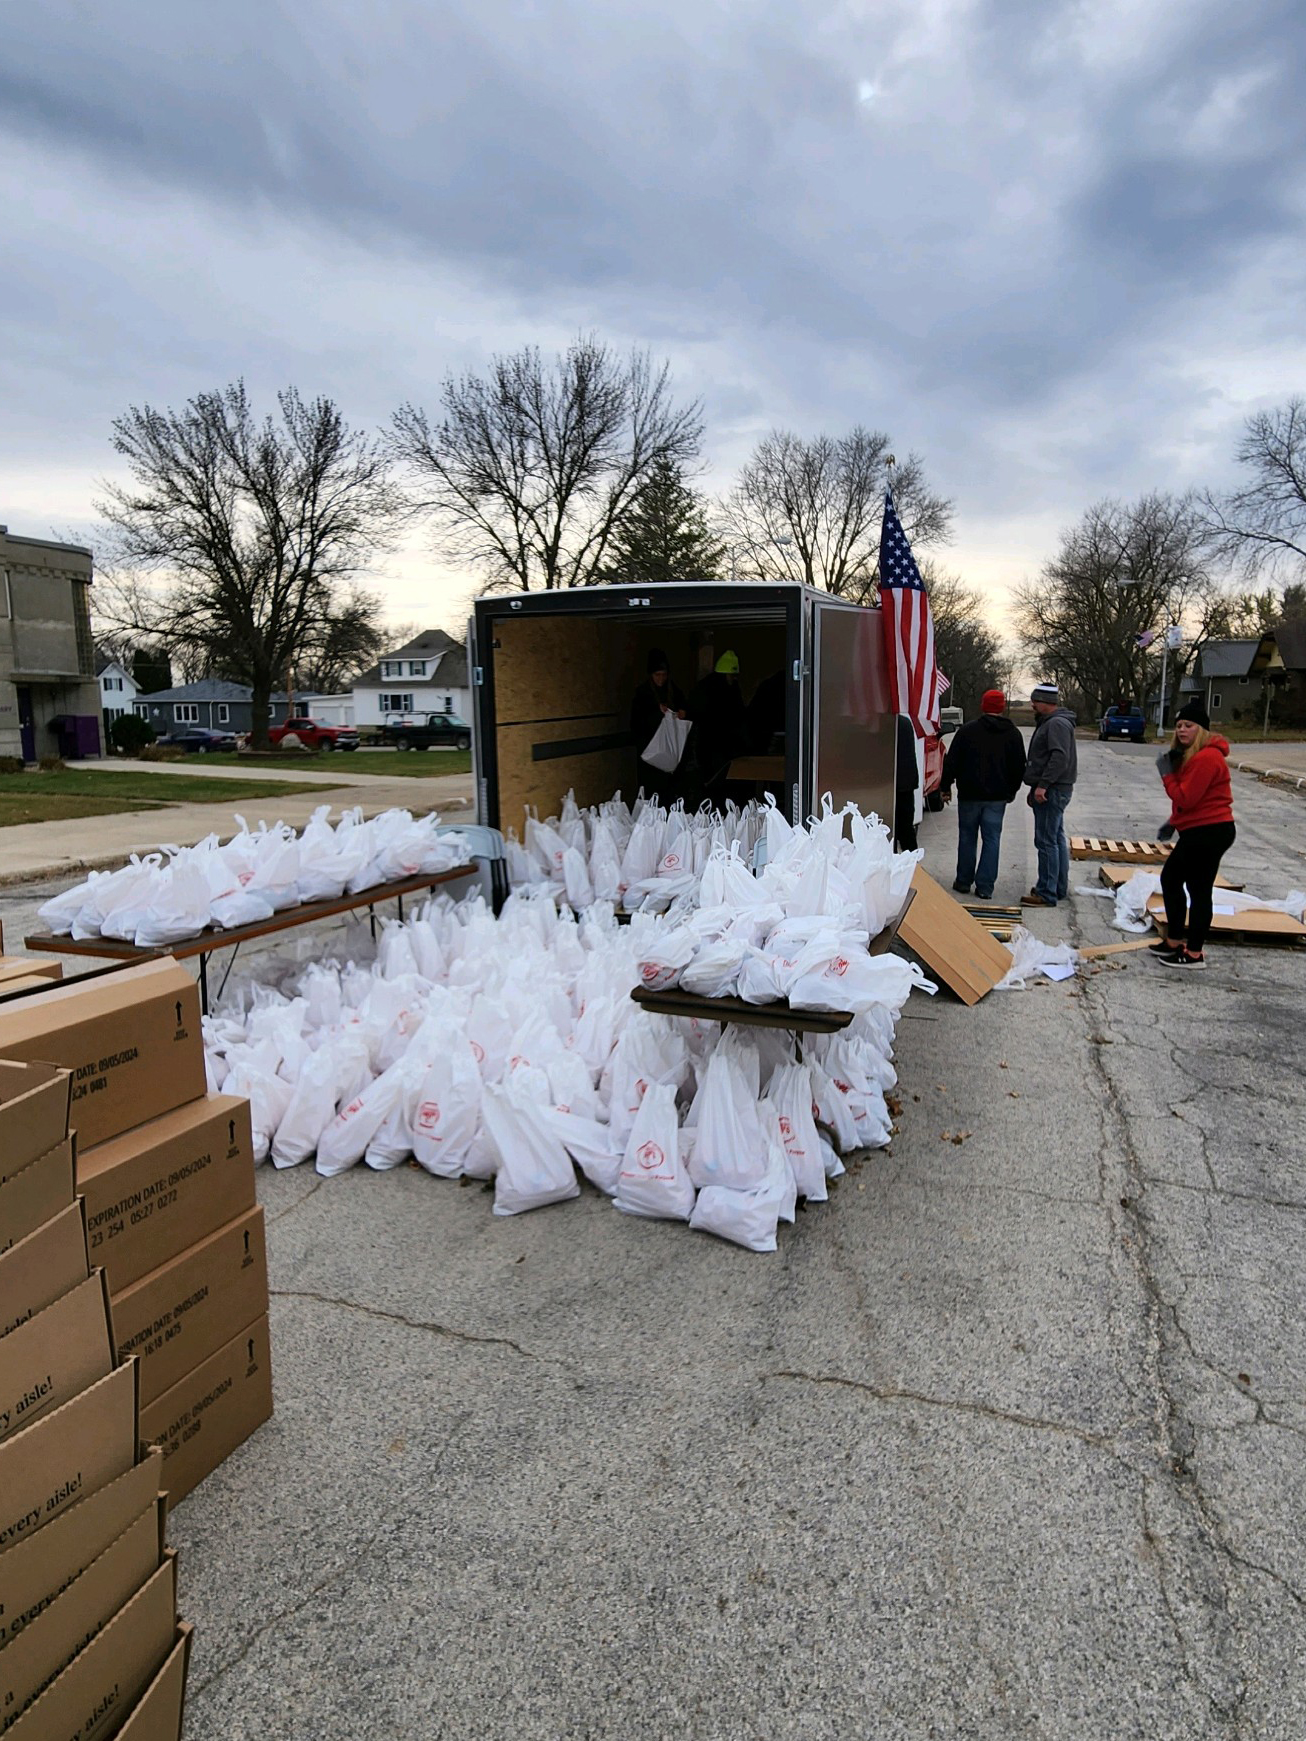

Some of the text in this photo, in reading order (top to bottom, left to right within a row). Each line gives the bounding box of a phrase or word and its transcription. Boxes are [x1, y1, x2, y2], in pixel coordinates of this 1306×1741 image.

[98, 1046, 139, 1073] 09/05/2024
[87, 1153, 212, 1232] EXPIRATION DATE: 09/05/2024
[91, 1189, 178, 1249] 23 254 05:27 0272
[15, 1375, 54, 1415] aisle!
[46, 1472, 83, 1513] aisle!
[85, 1683, 120, 1732] aisle!
